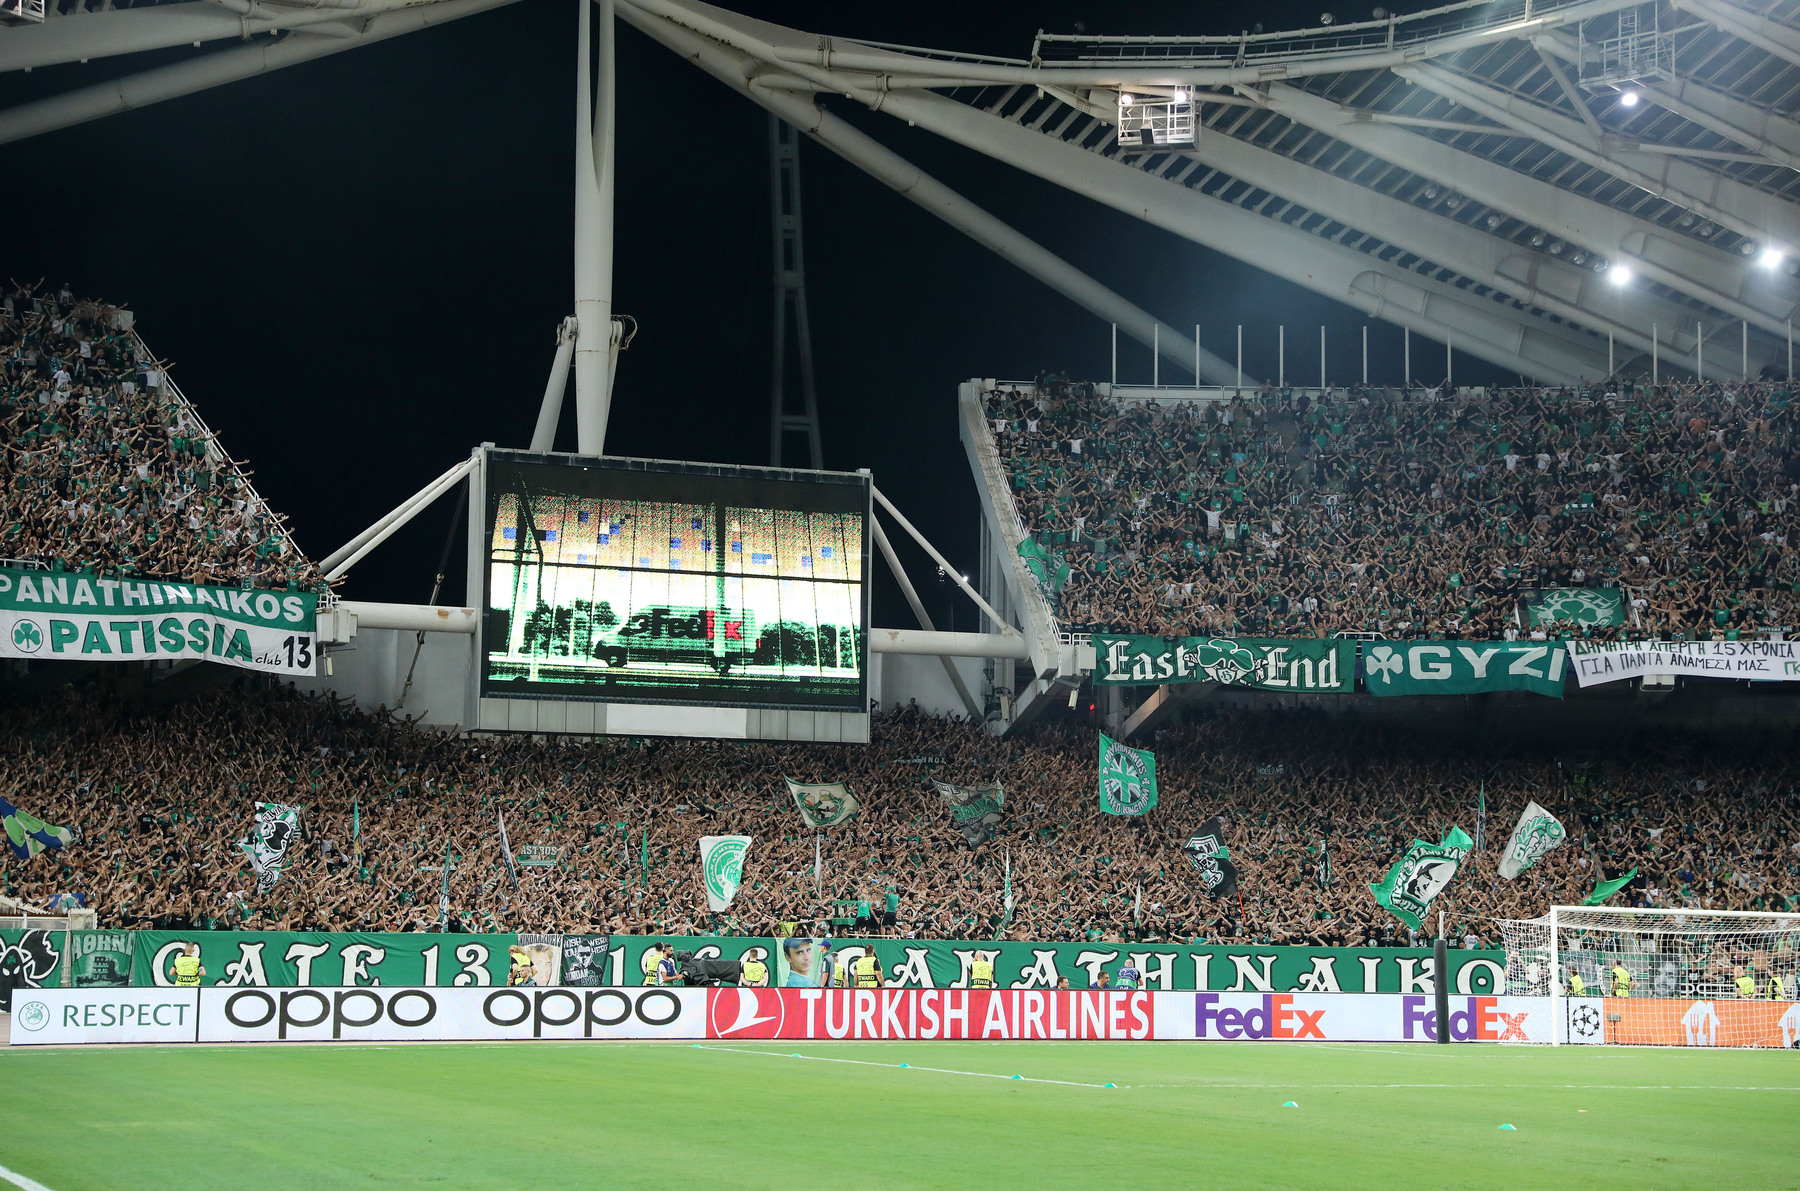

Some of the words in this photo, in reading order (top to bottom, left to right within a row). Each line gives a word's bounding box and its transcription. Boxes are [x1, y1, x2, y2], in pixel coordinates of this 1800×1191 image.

[49, 617, 253, 662] PATISSIA
[255, 651, 283, 667] club
[282, 635, 313, 669] 13
[1713, 642, 1736, 656] 15
[1740, 642, 1795, 658] ΧΡΟΝΙΑ
[1102, 638, 1192, 683] East
[1259, 645, 1342, 688] End
[1407, 645, 1566, 683] GYZI
[1580, 656, 1614, 676] ΓΙΑ
[1737, 659, 1770, 672] ΜΑΣ
[152, 942, 386, 986] GATE
[420, 943, 491, 986] 13
[838, 945, 1508, 994] PANATHINAIKO
[25, 1003, 44, 1011] UEFA
[63, 1003, 191, 1027] RESPECT
[224, 989, 437, 1040] oppo
[483, 989, 682, 1038] oppo
[799, 988, 970, 1039] TURKISH
[981, 989, 1150, 1039] AIRLINES
[1195, 993, 1326, 1039] FedEx
